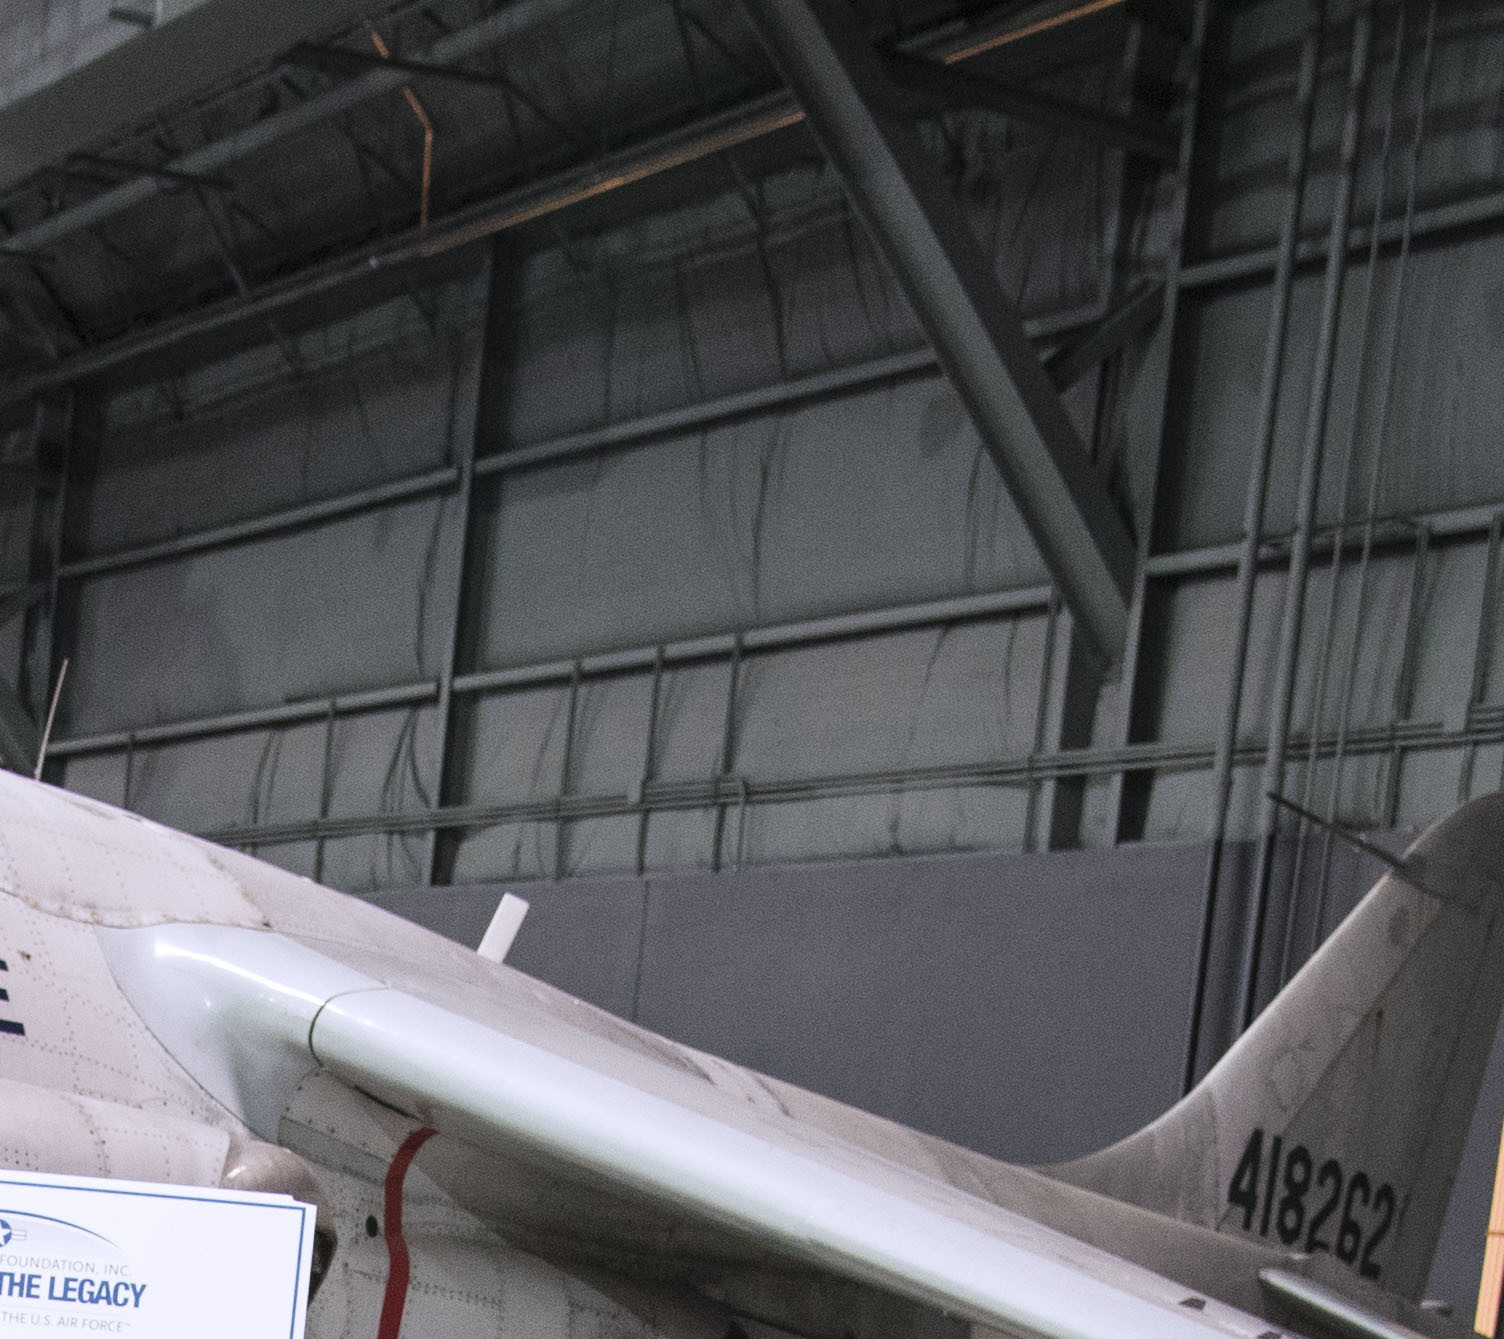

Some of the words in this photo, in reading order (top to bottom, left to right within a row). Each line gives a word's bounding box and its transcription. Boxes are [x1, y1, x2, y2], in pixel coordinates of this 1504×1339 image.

[1228, 1128, 1393, 1278] 418262
[47, 1275, 147, 1309] LEGACY
[0, 1310, 27, 1324] THE
[56, 1315, 78, 1329] AIR
